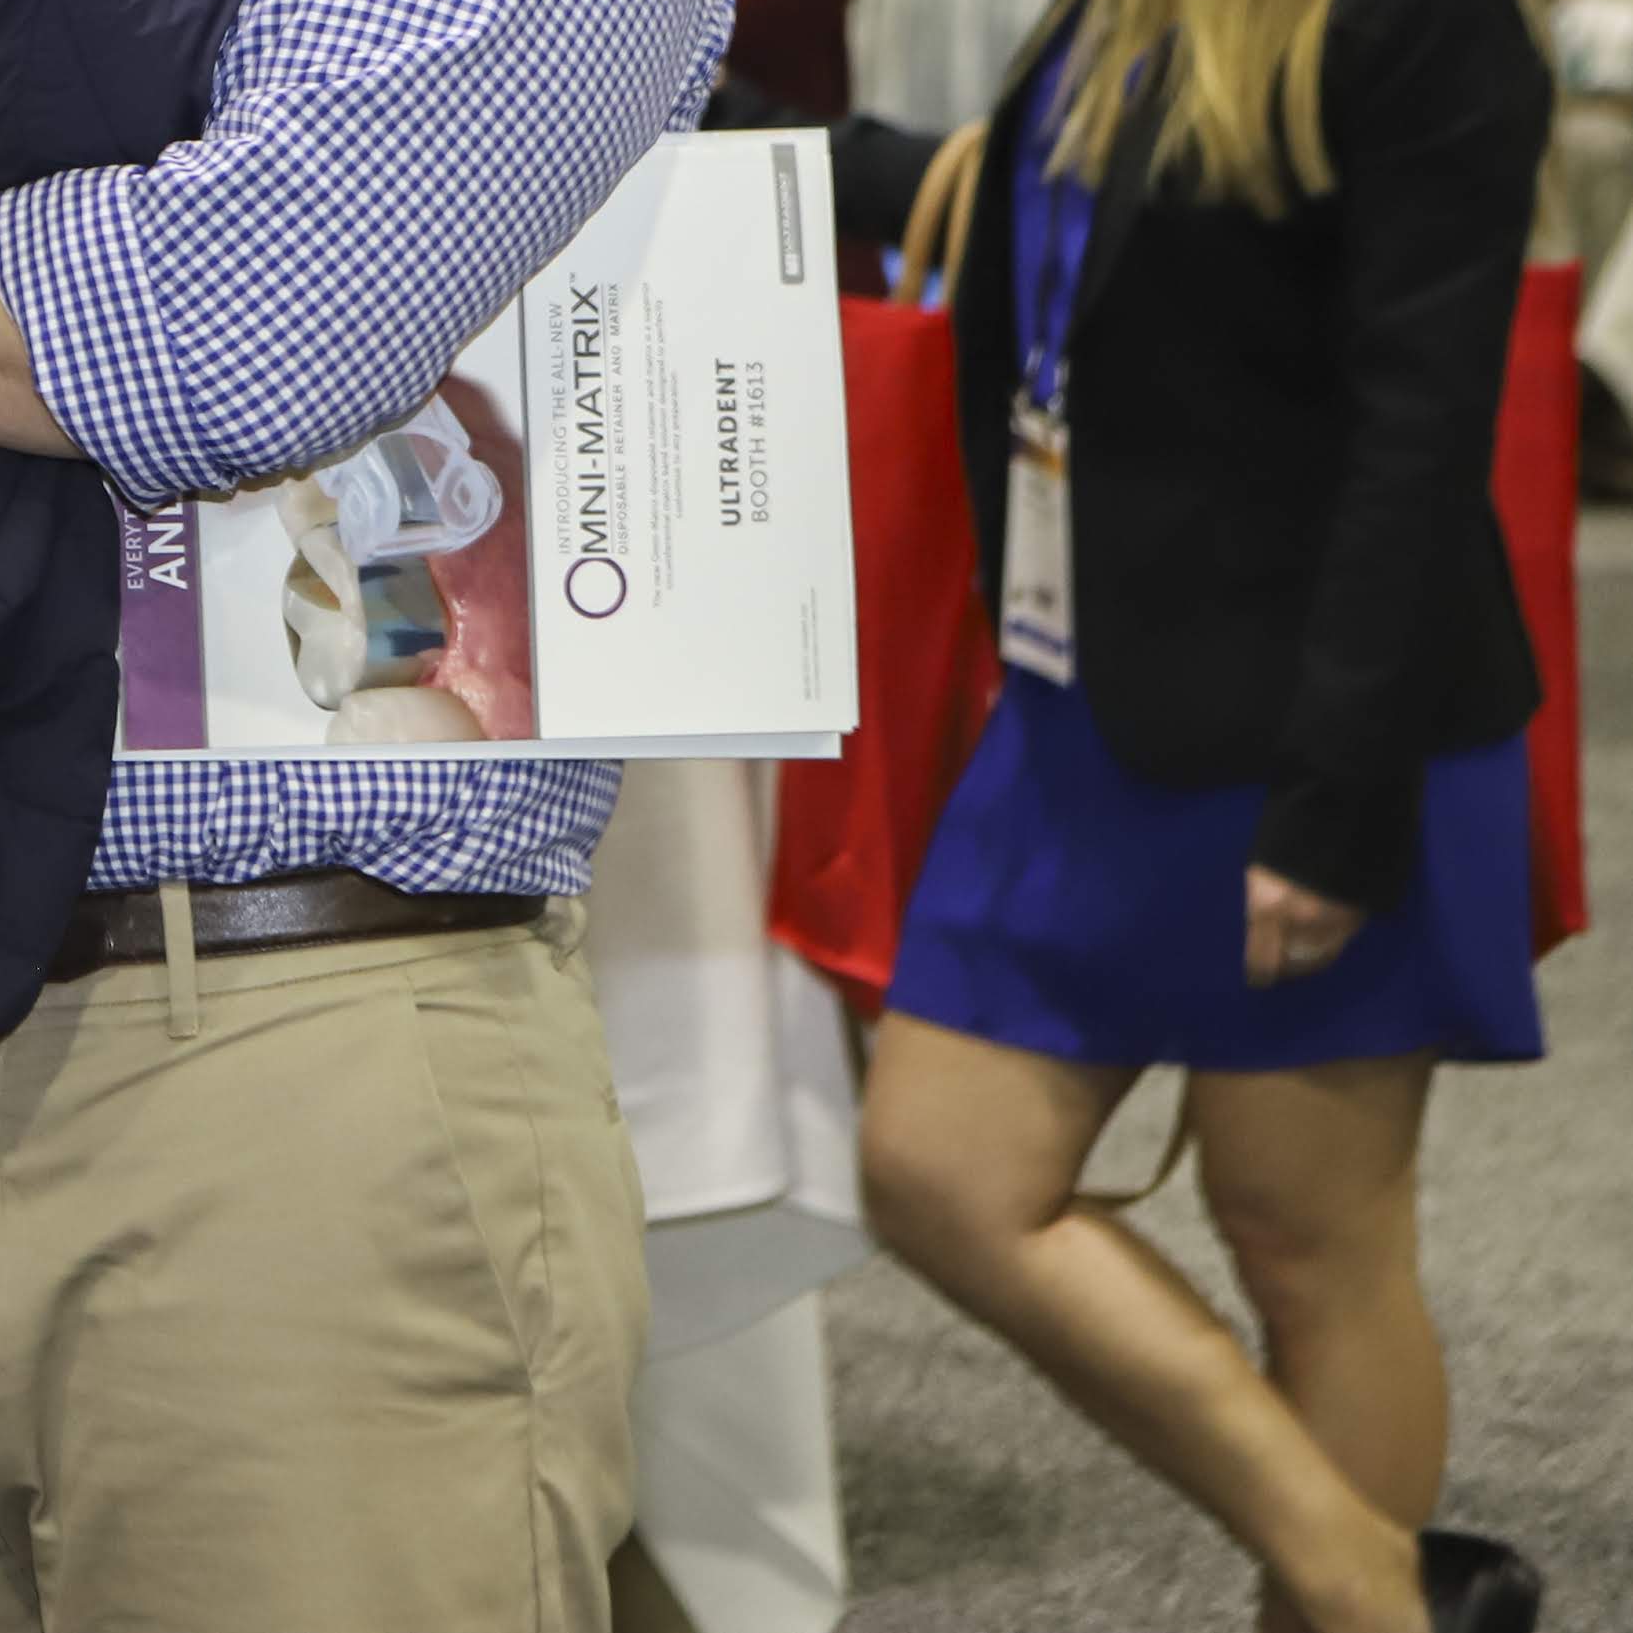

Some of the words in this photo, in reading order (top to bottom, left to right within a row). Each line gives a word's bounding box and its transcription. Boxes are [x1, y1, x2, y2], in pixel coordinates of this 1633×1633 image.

[549, 303, 565, 381] ALL-NEW
[608, 283, 620, 337] MATRIX
[552, 386, 567, 421] THE
[612, 384, 624, 454] RETAINER
[746, 361, 765, 428] #1613
[715, 358, 741, 527] ULTRADENT
[749, 438, 769, 522] BOOTH
[552, 426, 571, 554] INTRODUCING
[615, 464, 629, 555] DISPOSABLE
[124, 508, 144, 590] EVERYT
